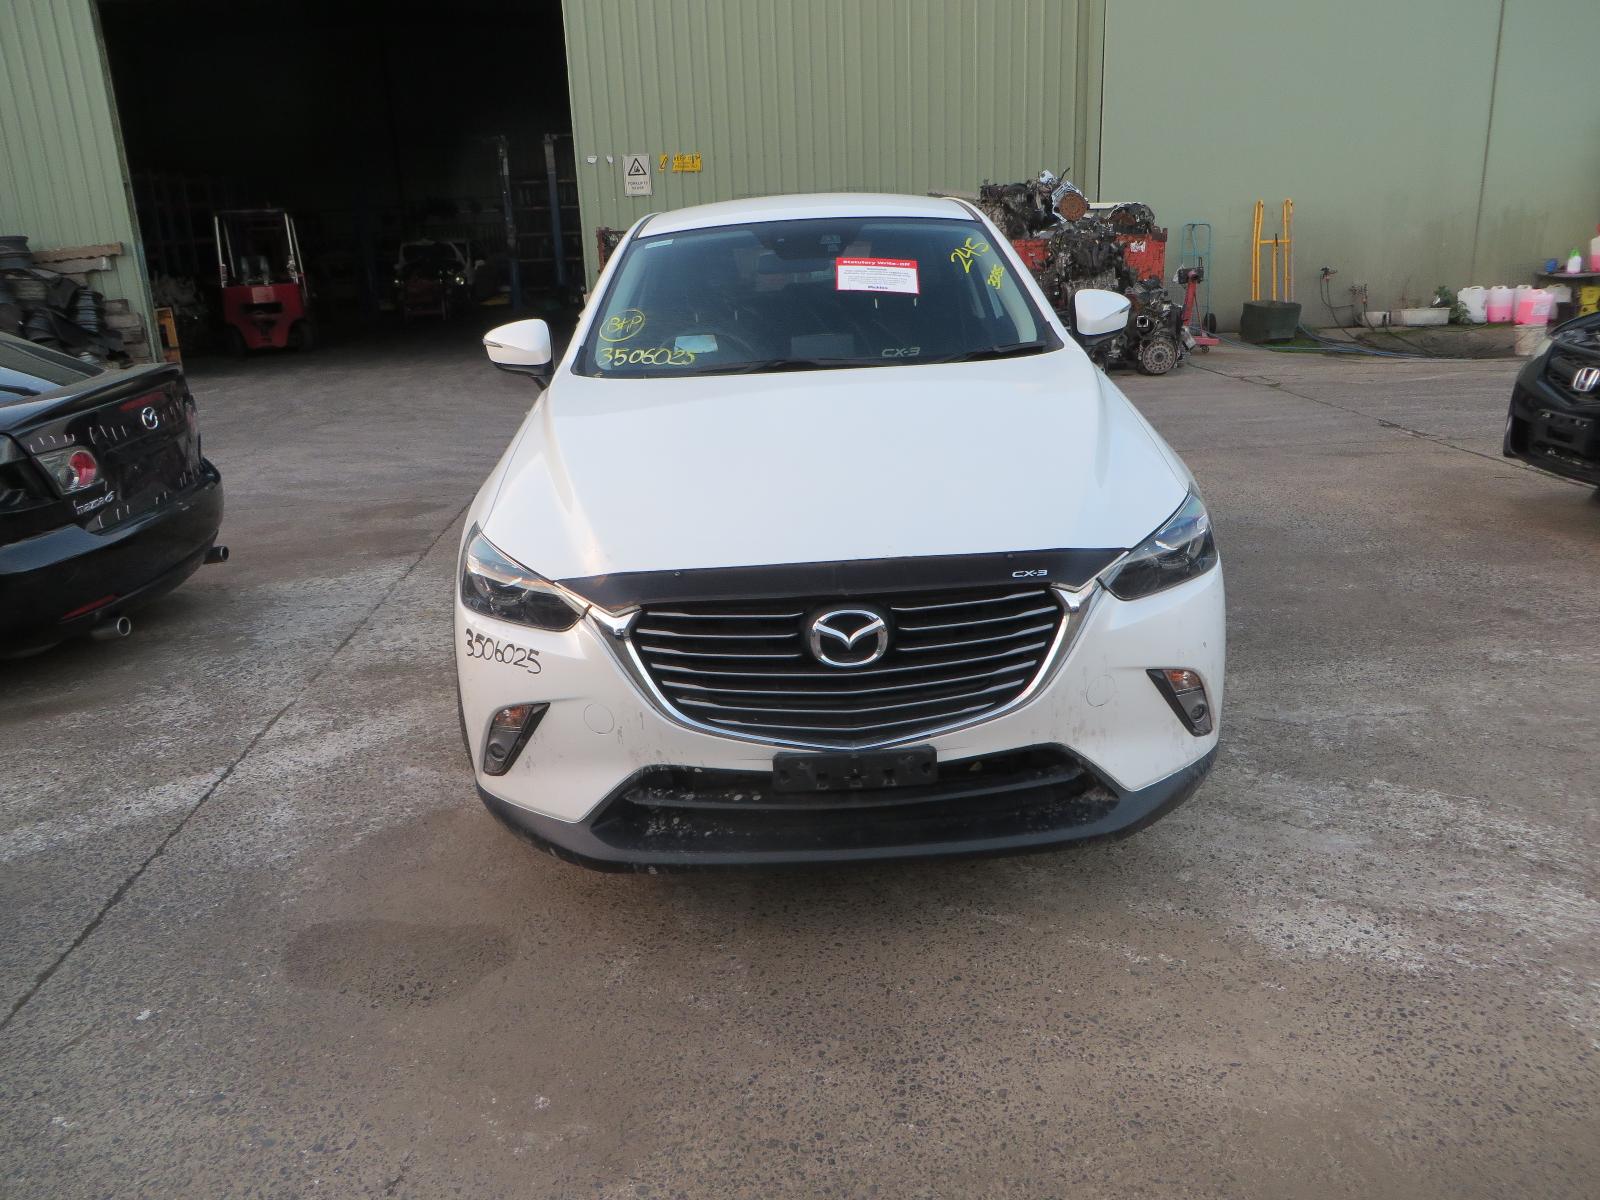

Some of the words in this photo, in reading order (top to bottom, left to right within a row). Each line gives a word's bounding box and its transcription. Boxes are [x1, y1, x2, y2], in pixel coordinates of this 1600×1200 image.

[881, 346, 921, 358] CX-3
[1011, 569, 1048, 578] CX-3
[465, 628, 542, 675] 3506025
